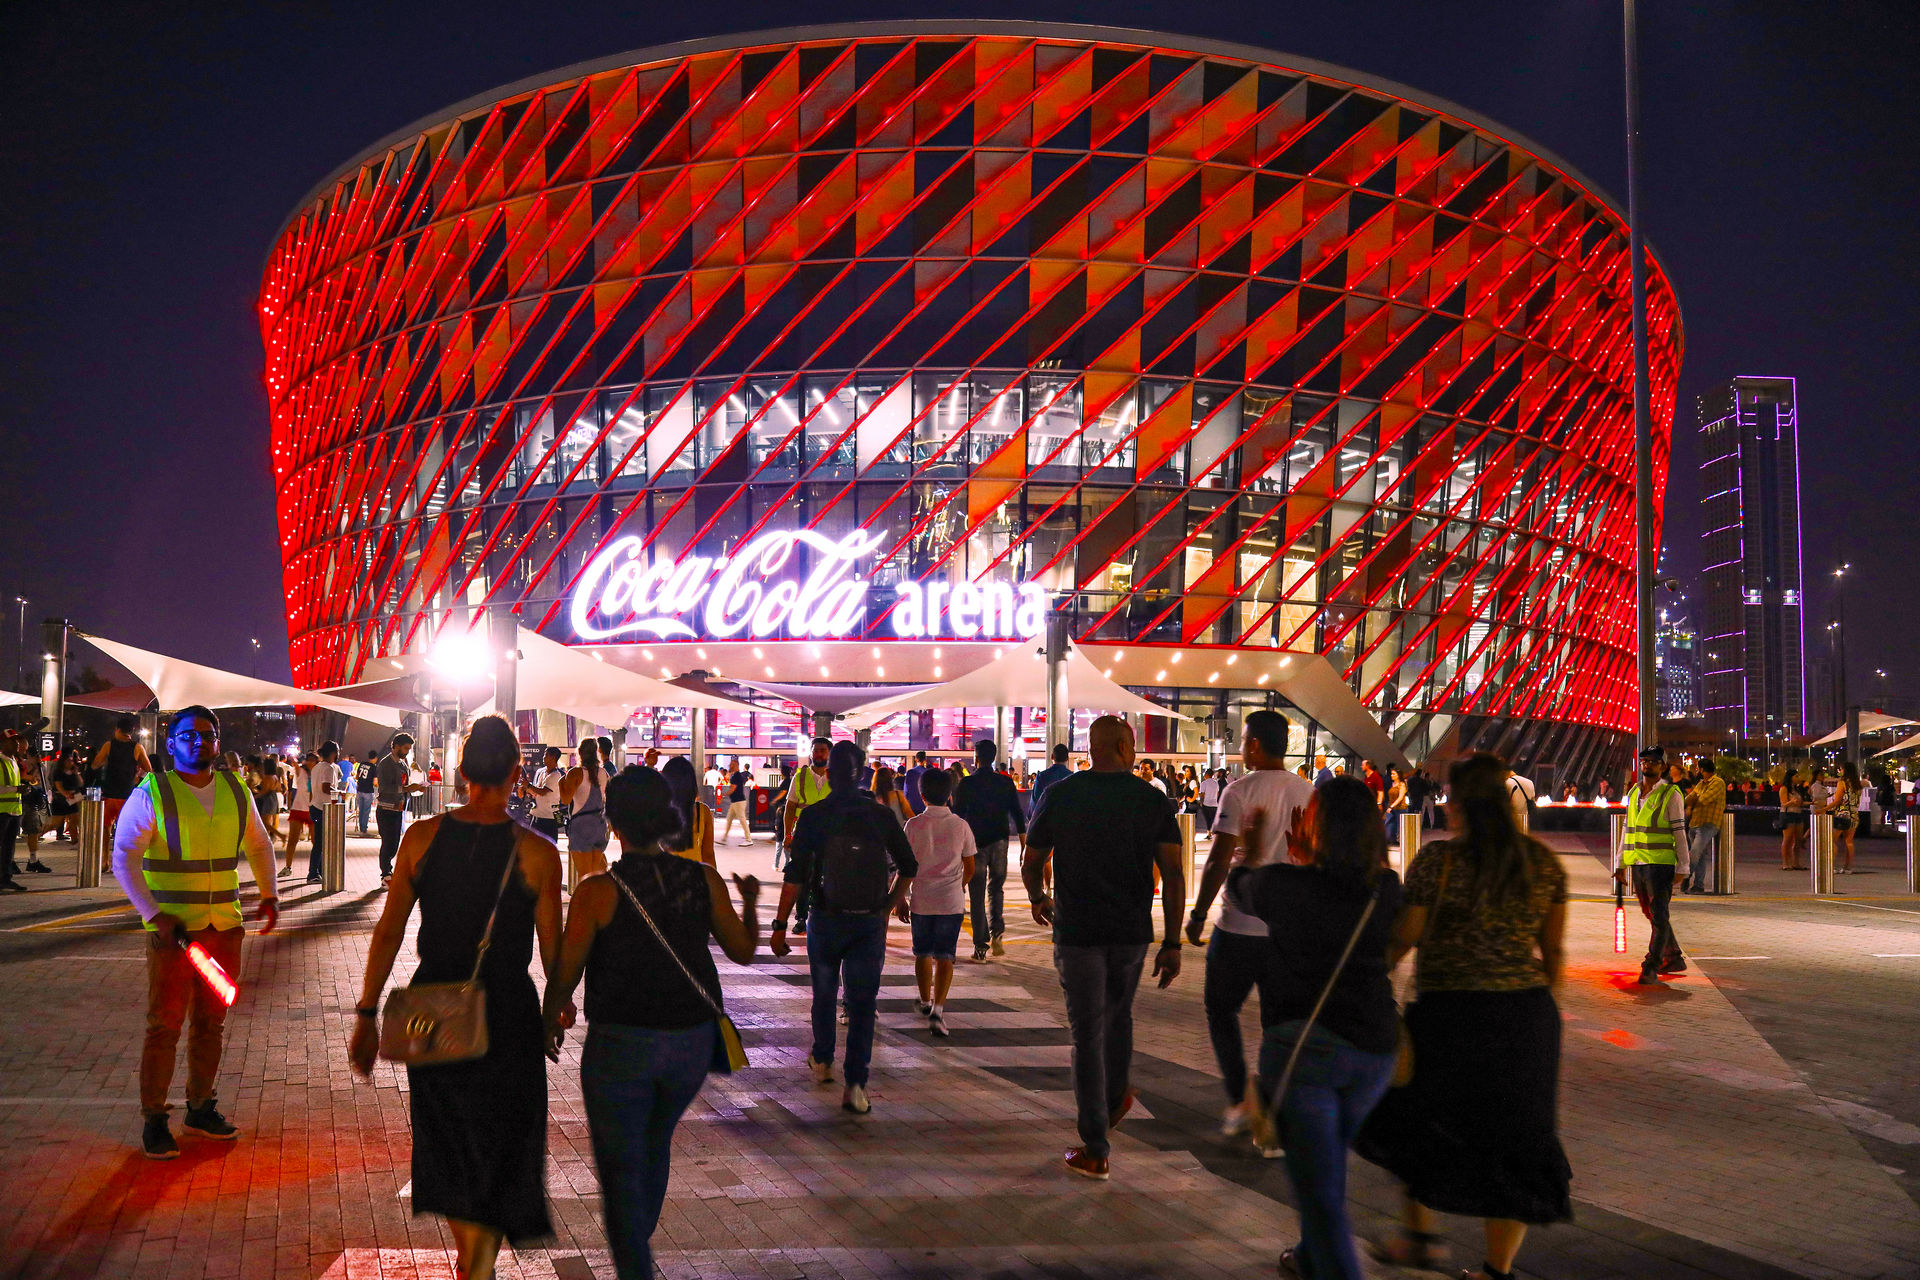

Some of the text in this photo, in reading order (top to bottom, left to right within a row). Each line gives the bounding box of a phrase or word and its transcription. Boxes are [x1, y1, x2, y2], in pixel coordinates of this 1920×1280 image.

[570, 529, 1046, 640] Coca-Cola arena
[42, 739, 54, 751] B
[797, 735, 810, 757] B
[1012, 737, 1027, 760] A
[359, 768, 369, 779] 79
